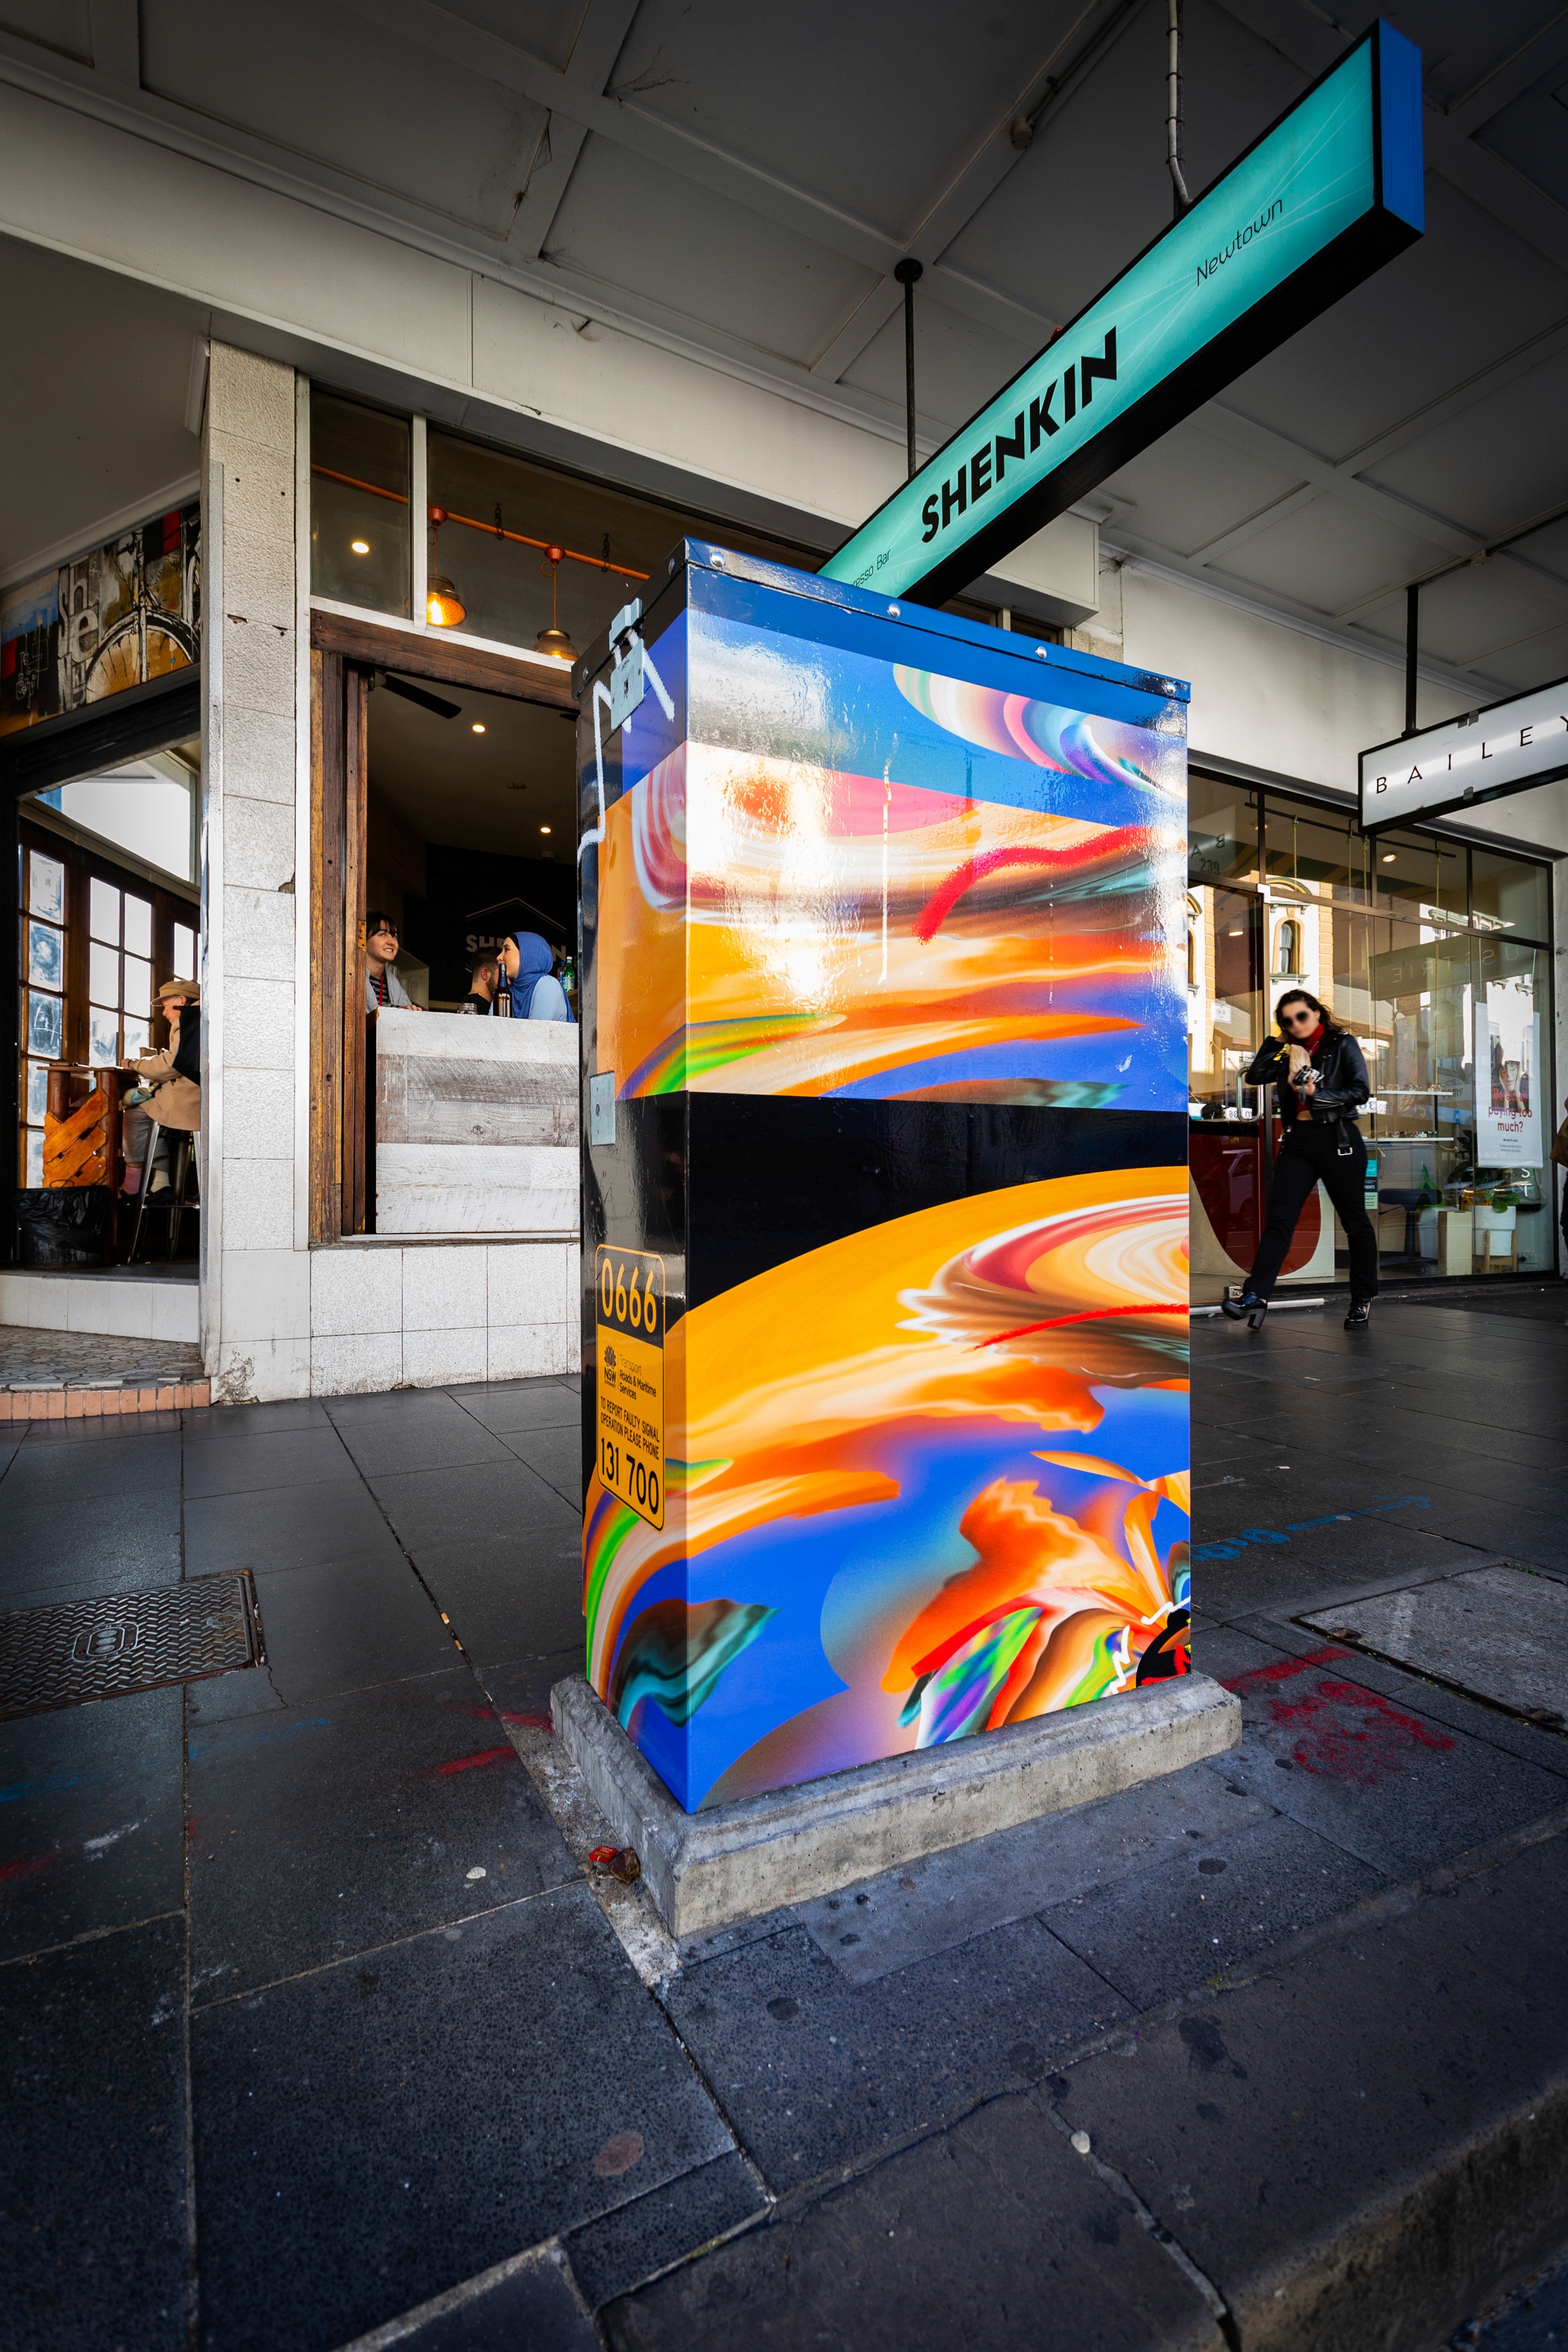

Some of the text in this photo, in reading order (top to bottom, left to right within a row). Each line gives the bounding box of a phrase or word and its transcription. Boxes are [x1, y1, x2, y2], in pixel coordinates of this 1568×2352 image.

[1196, 199, 1283, 287] Newtown
[921, 325, 1118, 544] SHENKIN
[851, 549, 891, 588] resso Bar
[1200, 858, 1220, 876] 239
[1488, 1106, 1533, 1120] paying too
[1498, 1121, 1524, 1133] much?
[601, 1257, 657, 1333] 0666
[604, 1366, 617, 1383] NSW
[619, 1354, 642, 1376] Transport
[619, 1369, 633, 1385] Roads
[633, 1375, 637, 1387] &
[637, 1377, 657, 1397] Maritime
[619, 1382, 637, 1400] Services
[600, 1412, 659, 1460] OPERATION PLEASE PHONE
[601, 1396, 660, 1443] TO REPORT FAULTY SIGNAL
[601, 1437, 659, 1515] 131 700
